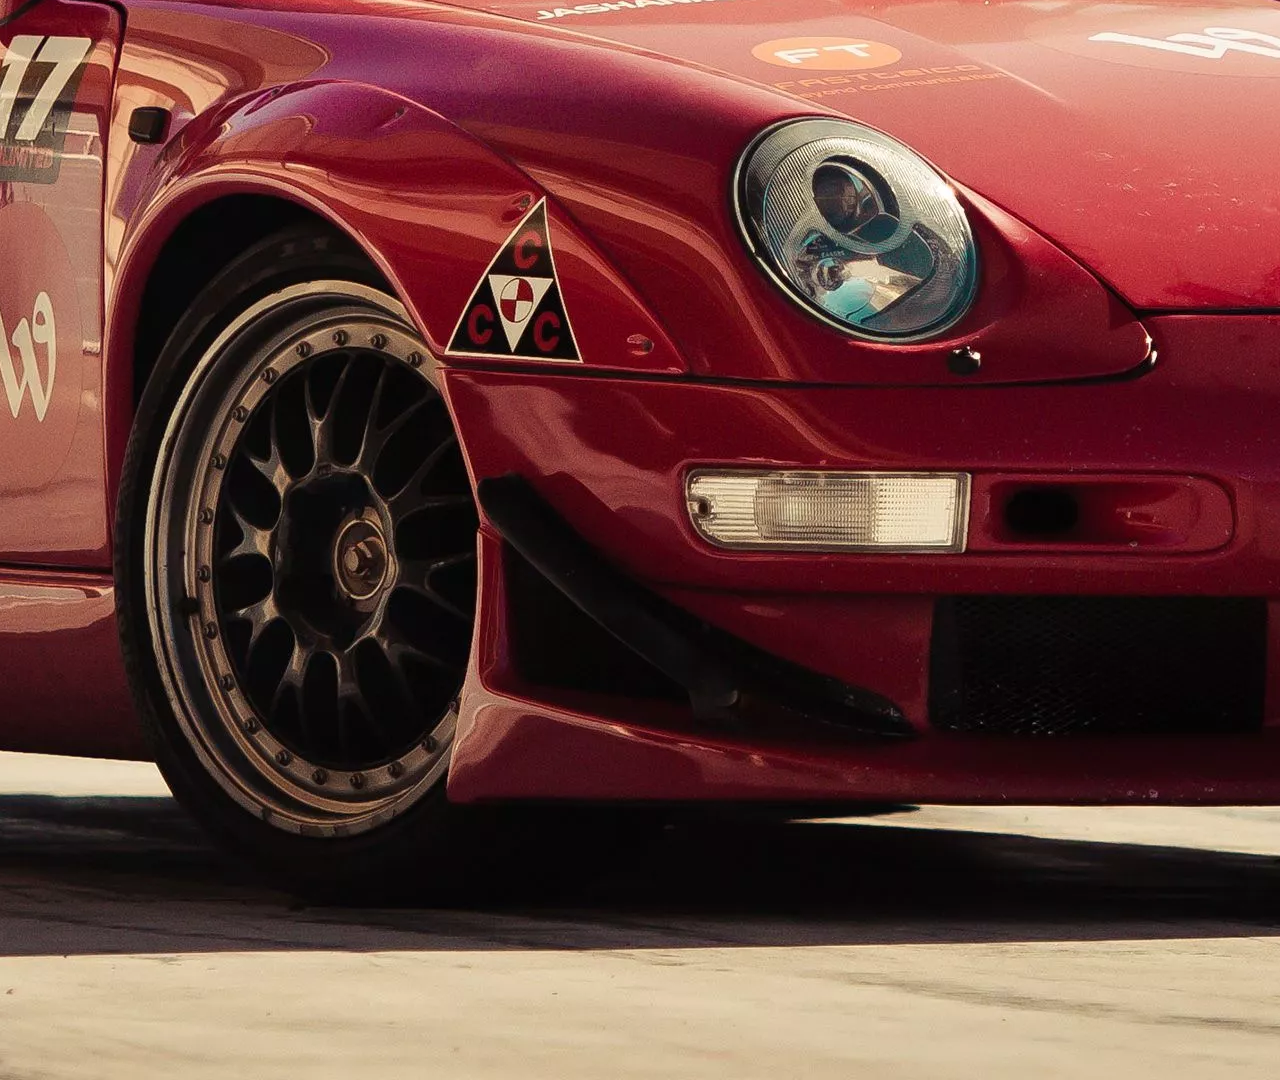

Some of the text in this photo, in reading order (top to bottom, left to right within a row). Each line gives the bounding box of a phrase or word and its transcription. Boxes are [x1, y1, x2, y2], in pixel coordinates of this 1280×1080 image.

[774, 43, 871, 65] FT
[513, 230, 543, 269] C
[467, 304, 561, 352] C C
